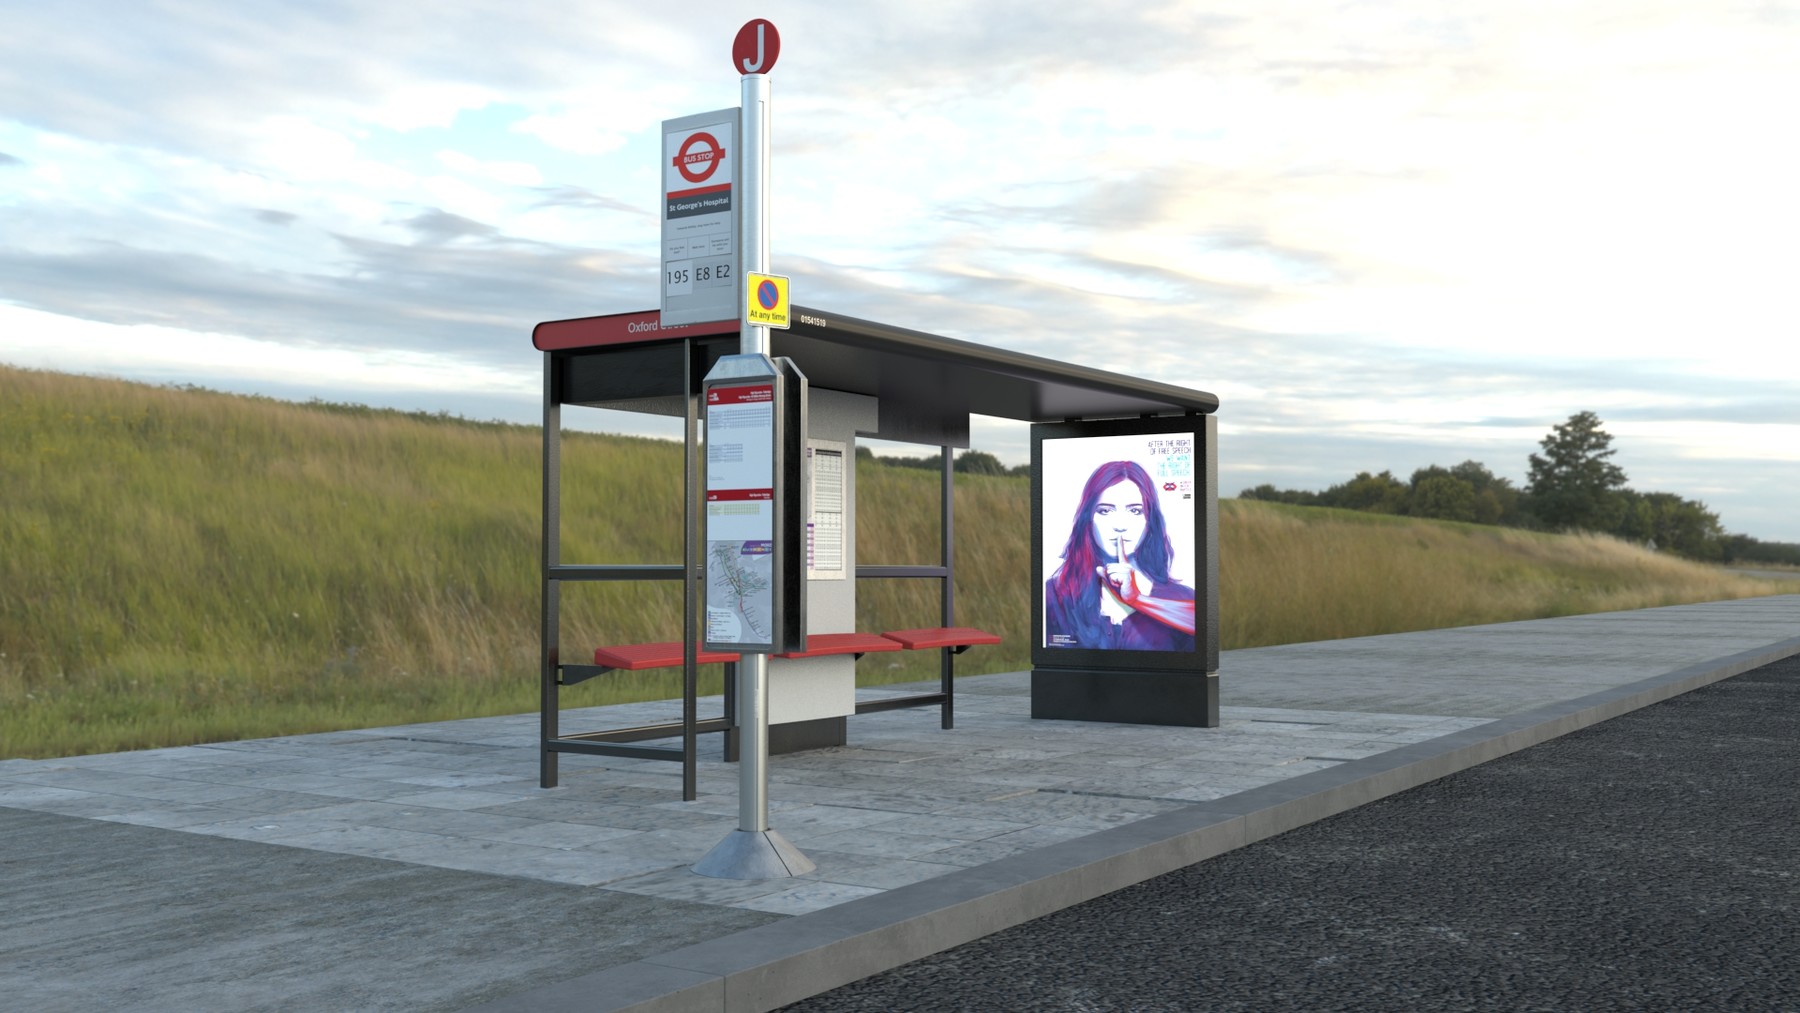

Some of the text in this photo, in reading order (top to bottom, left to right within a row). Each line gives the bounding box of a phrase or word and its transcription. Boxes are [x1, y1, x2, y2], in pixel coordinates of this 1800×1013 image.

[743, 24, 764, 72] J
[684, 152, 715, 163] BUS STOP
[677, 201, 702, 211] George's
[703, 197, 729, 207] Hospital
[668, 264, 730, 284] 195 E8 E2
[750, 310, 786, 321] At any time
[628, 320, 658, 333] Oxford
[1150, 447, 1156, 455] OF
[1172, 446, 1191, 454] SPEECH
